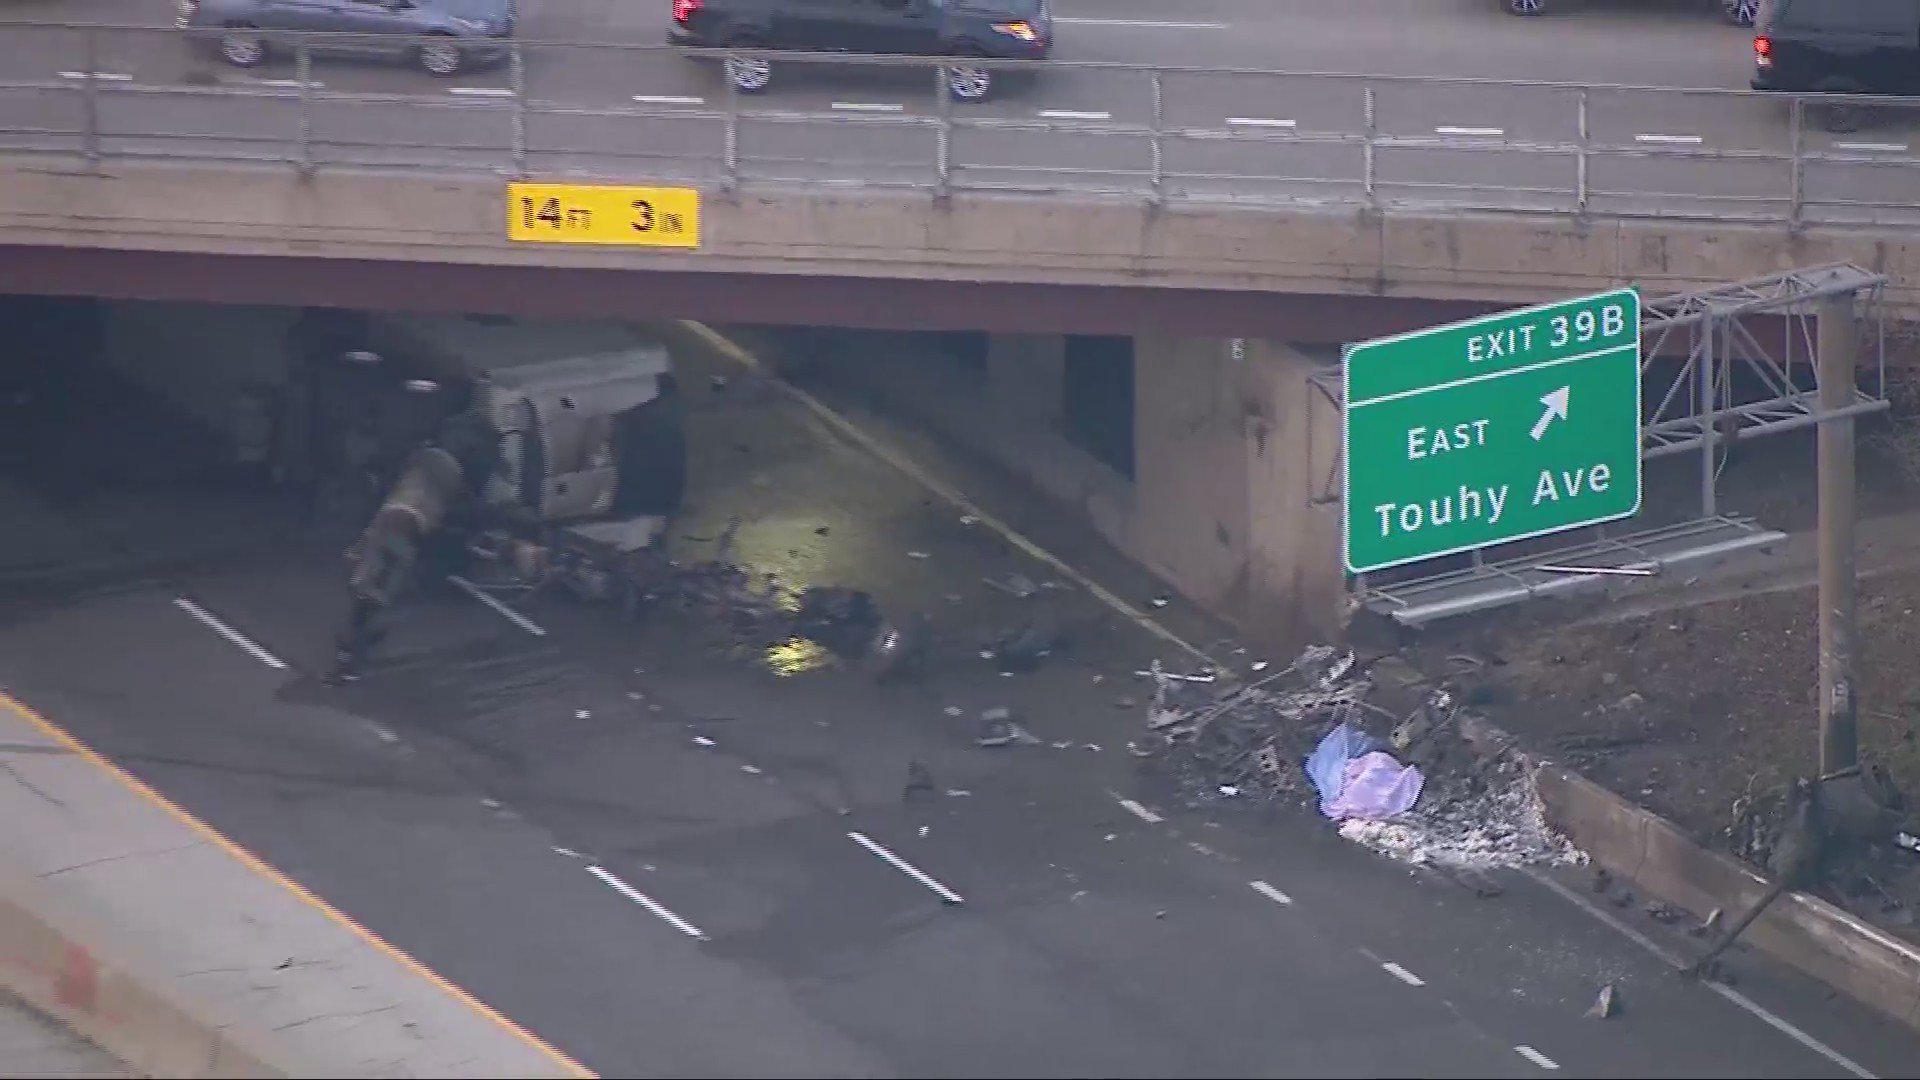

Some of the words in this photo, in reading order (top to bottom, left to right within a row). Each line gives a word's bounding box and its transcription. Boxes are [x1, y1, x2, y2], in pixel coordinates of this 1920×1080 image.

[1467, 323, 1536, 363] EXIT
[1549, 304, 1624, 347] 39B
[1407, 419, 1489, 460] EAST
[1374, 484, 1509, 537] Touhy
[1532, 463, 1611, 506] Ave
